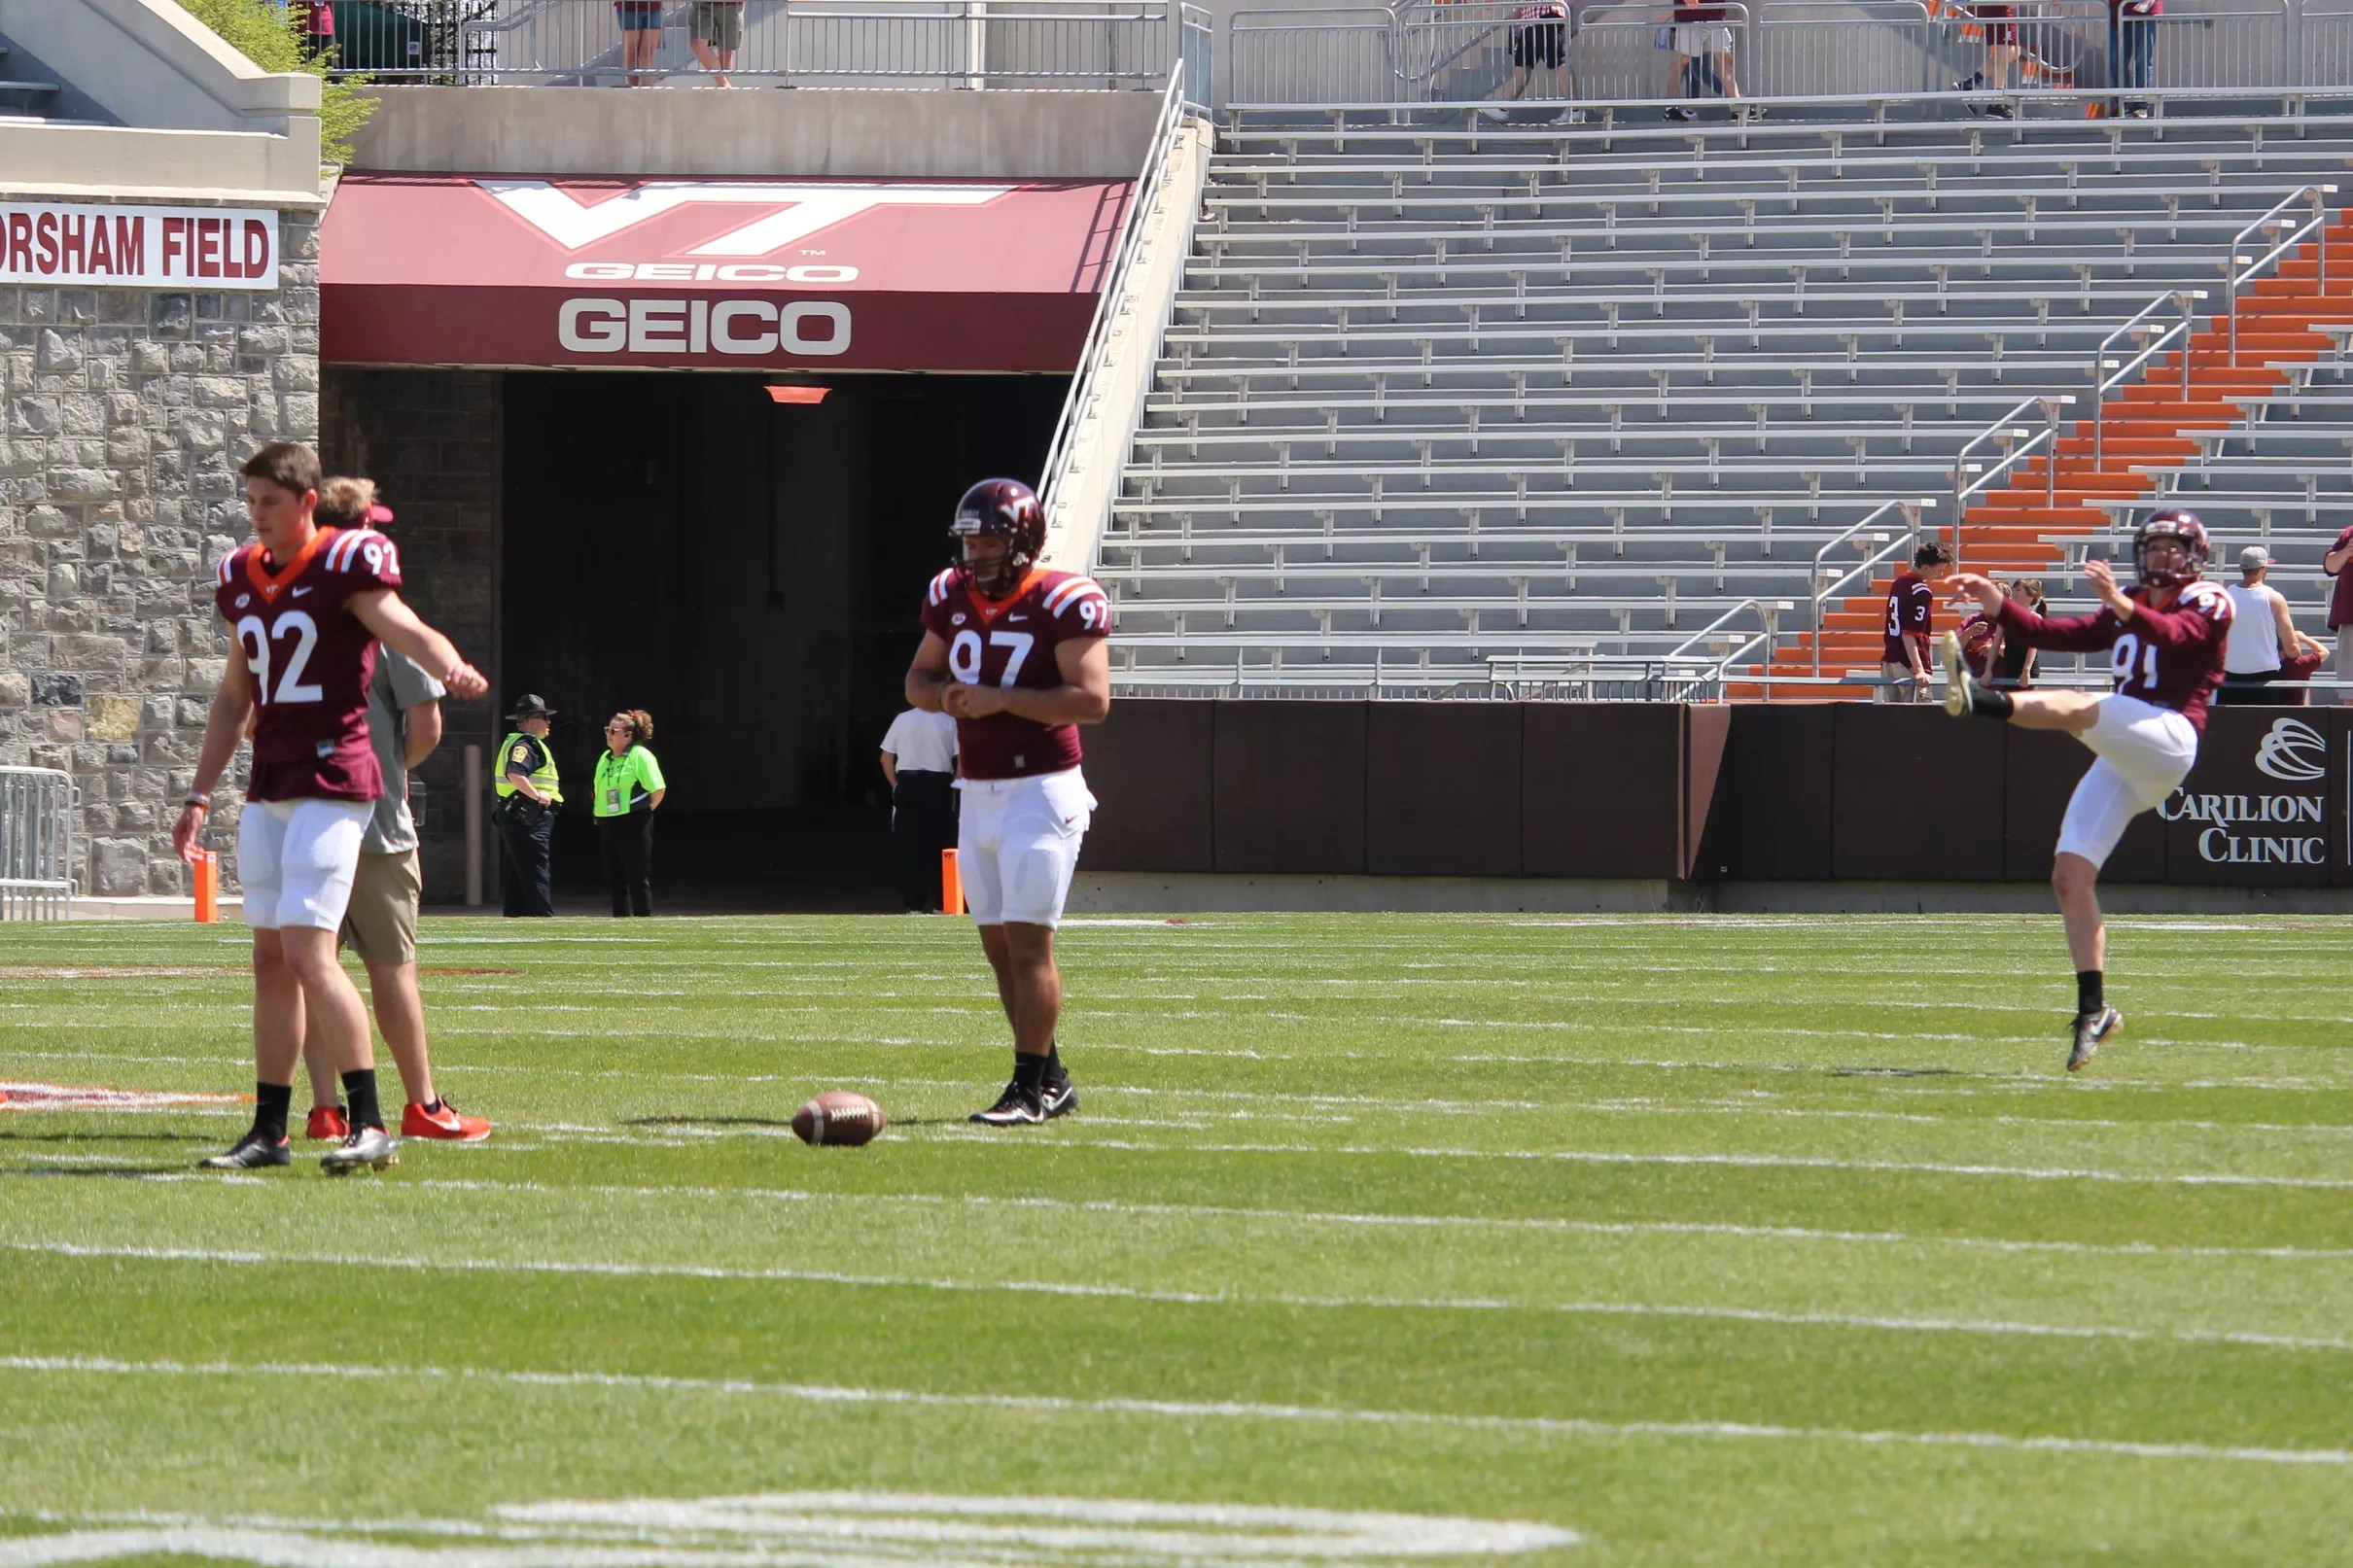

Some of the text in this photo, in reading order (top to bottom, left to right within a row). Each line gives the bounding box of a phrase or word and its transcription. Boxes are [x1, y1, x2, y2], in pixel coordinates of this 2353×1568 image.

[0, 211, 270, 279] RSHAM FIELD
[564, 262, 860, 283] GEICO
[558, 297, 852, 356] GEICO
[1078, 599, 1109, 630] 97
[1887, 596, 1901, 637] 3
[1914, 605, 1926, 622] 3
[2197, 592, 2228, 620] 91
[236, 610, 324, 706] 92
[948, 629, 1035, 689] 97
[2111, 633, 2158, 695] 91
[2156, 785, 2325, 827] CARILION
[2197, 827, 2326, 865] CLINIC
